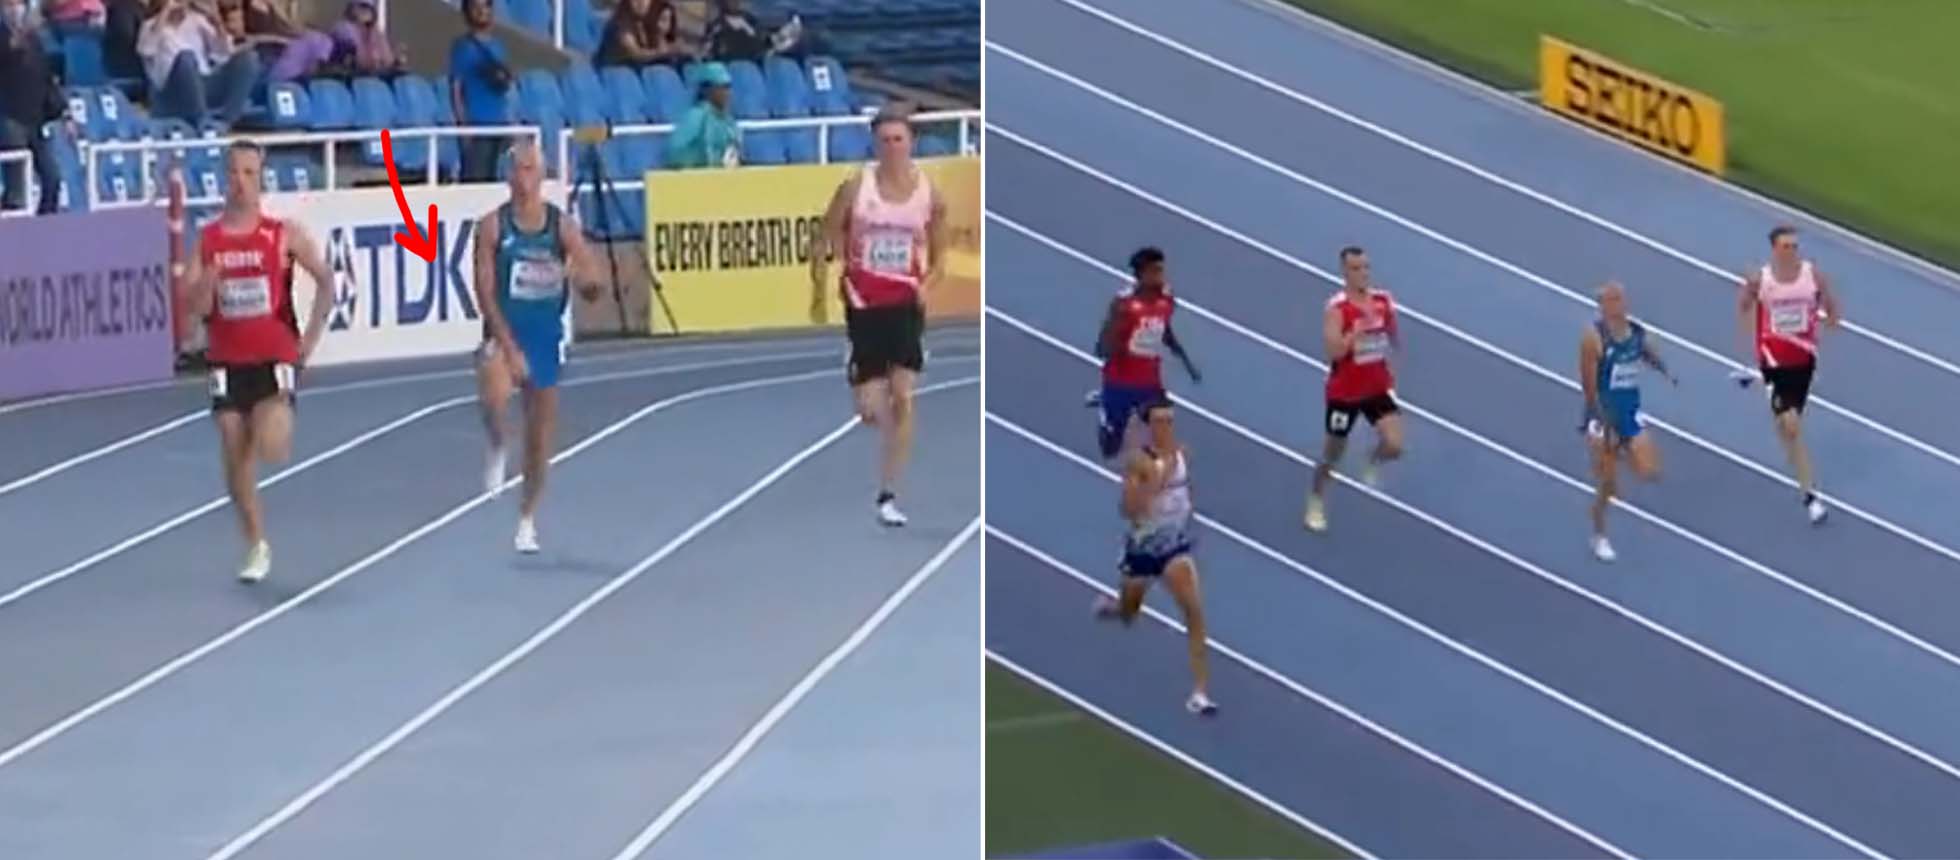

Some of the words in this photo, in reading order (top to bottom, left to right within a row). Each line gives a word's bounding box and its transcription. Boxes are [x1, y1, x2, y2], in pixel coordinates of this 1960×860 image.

[1565, 54, 1699, 156] SEIKO
[354, 219, 479, 328] TDK
[655, 222, 713, 272] EVERY
[718, 216, 792, 270] BREATH
[58, 264, 167, 342] ATHLETICS
